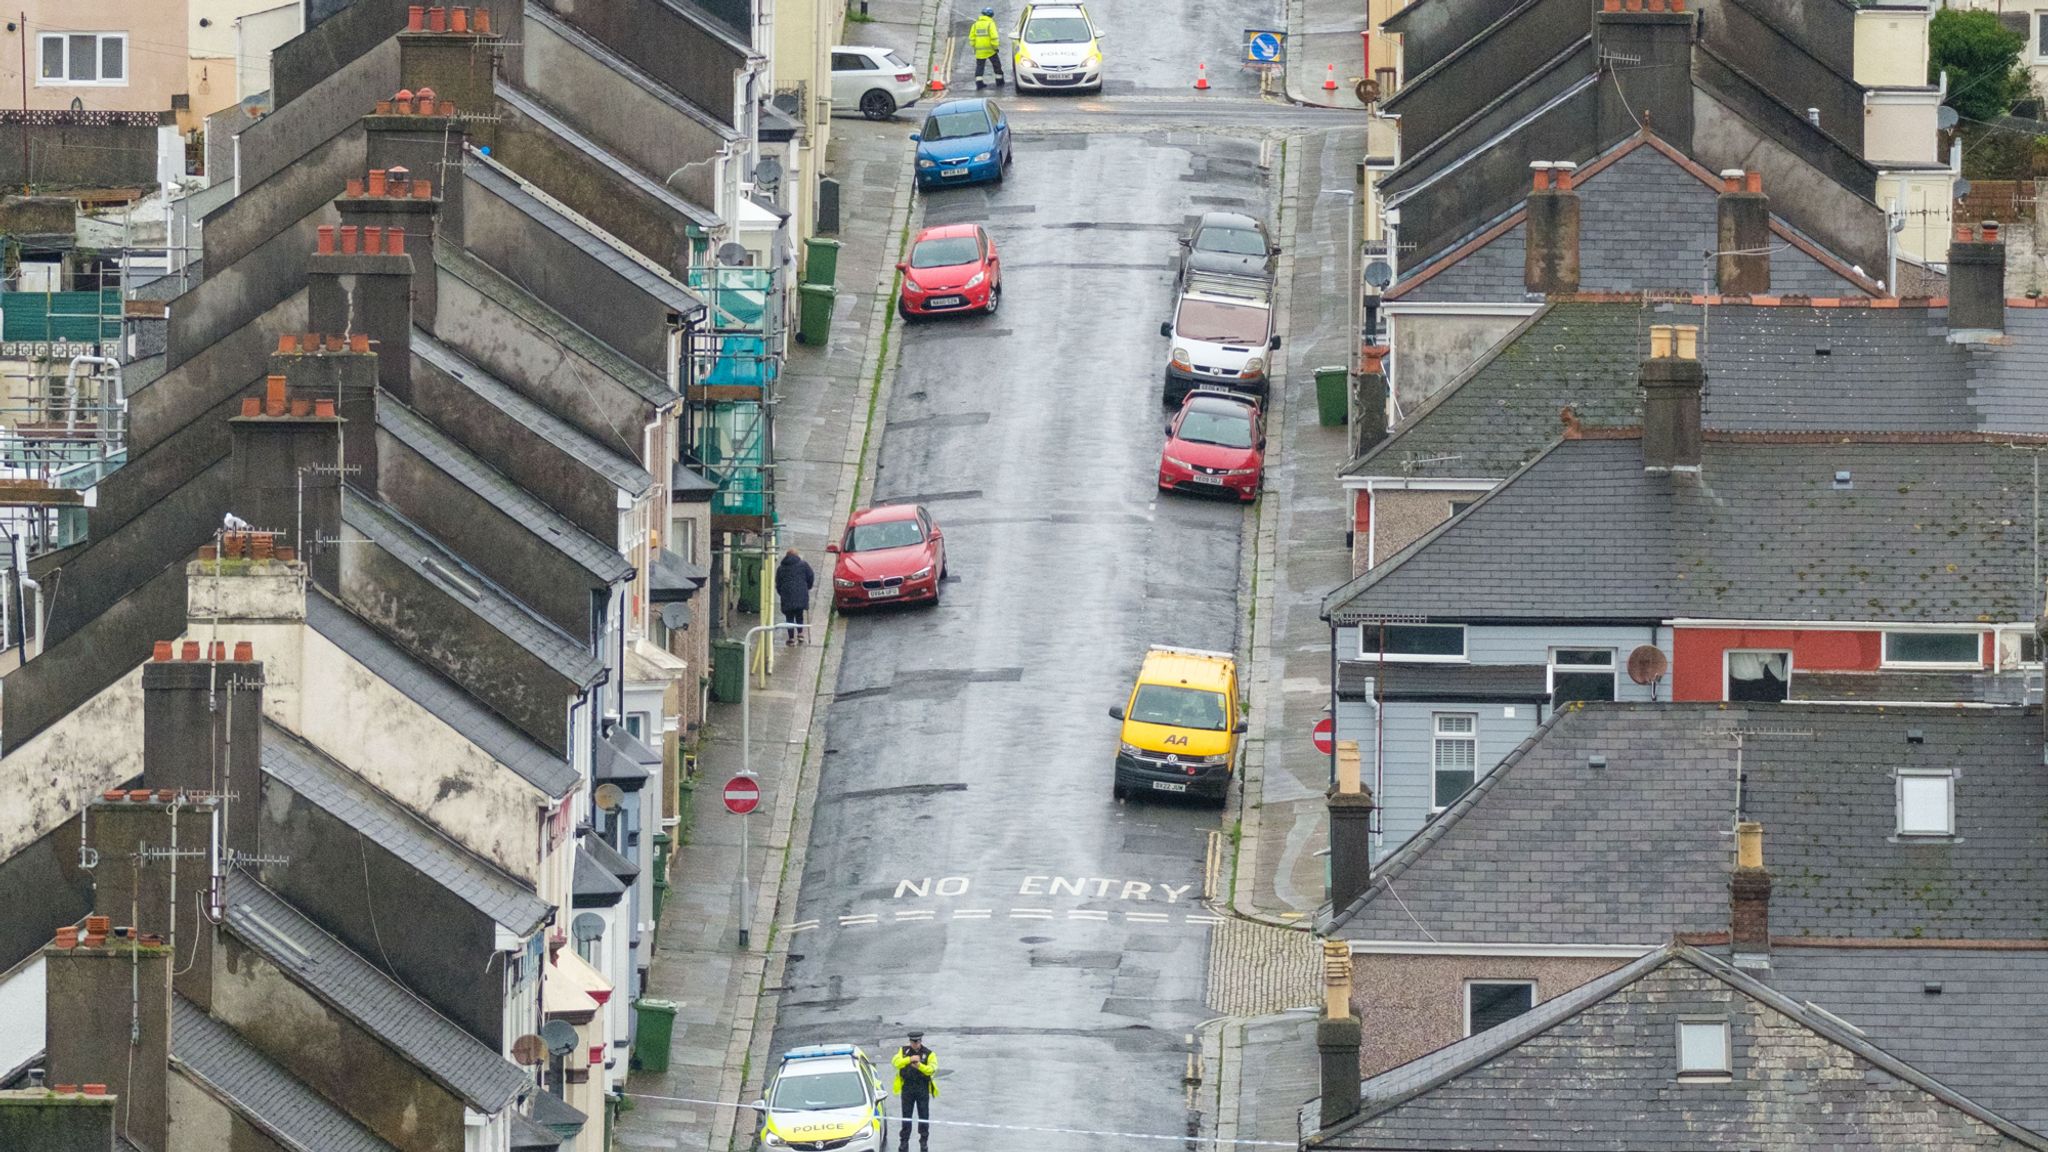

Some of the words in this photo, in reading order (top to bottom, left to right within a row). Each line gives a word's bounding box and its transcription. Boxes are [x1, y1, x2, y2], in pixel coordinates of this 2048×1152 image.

[1164, 734, 1188, 746] AA
[654, 845, 660, 856] 9
[893, 876, 970, 898] NO
[1018, 876, 1192, 903] ENTRY
[793, 1123, 845, 1133] POLICE
